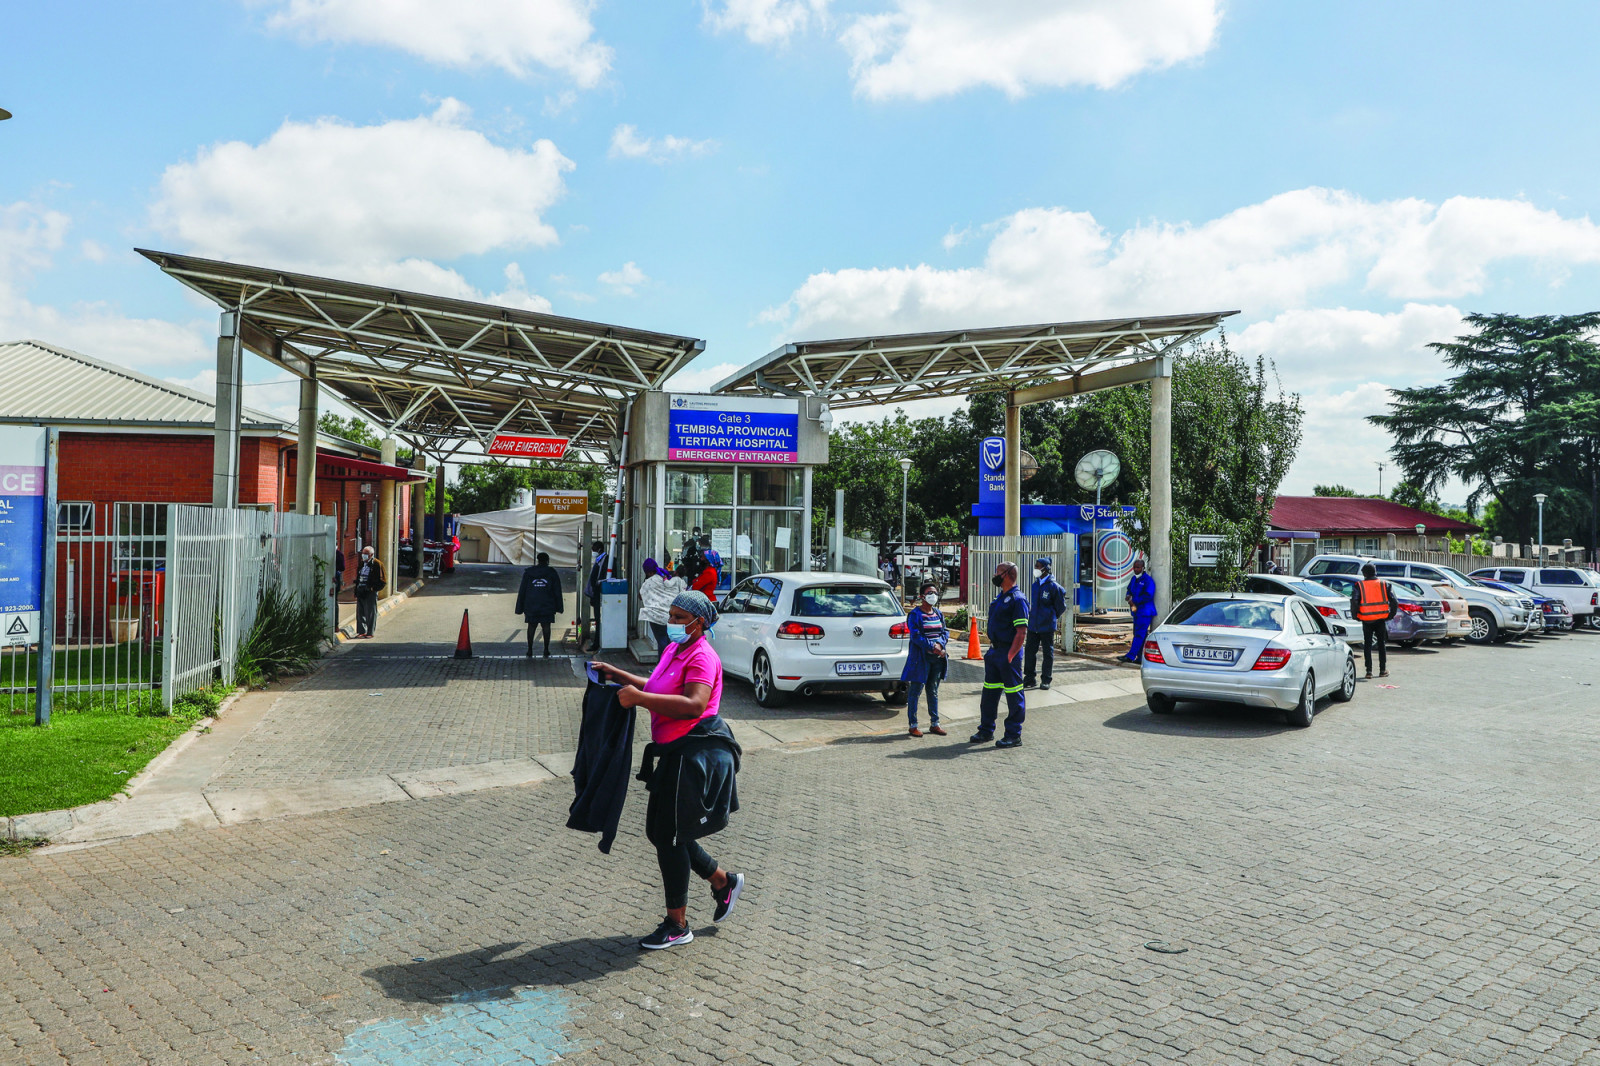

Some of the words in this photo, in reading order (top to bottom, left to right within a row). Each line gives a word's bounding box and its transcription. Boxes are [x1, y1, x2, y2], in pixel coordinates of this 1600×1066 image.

[718, 413, 742, 424] Gate
[744, 414, 751, 424] 3
[675, 424, 725, 435] TEMBISA
[727, 426, 792, 437] PROVINCIAL
[491, 440, 516, 451] 24HR
[515, 441, 566, 454] EMERGENCY
[679, 436, 732, 447] TERTIARY
[735, 438, 788, 449] HOSPITAL
[676, 450, 737, 460] EMERGENCY
[739, 452, 790, 462] ENTRANCE
[2, 473, 36, 492] CE
[983, 473, 1005, 482] Standa
[989, 483, 1005, 491] Bank
[1194, 540, 1217, 551] VISITORS
[1184, 648, 1194, 656] BM
[1196, 649, 1206, 657] 63
[1208, 650, 1218, 658] LK
[1223, 651, 1232, 660] GP
[872, 663, 881, 671] GP
